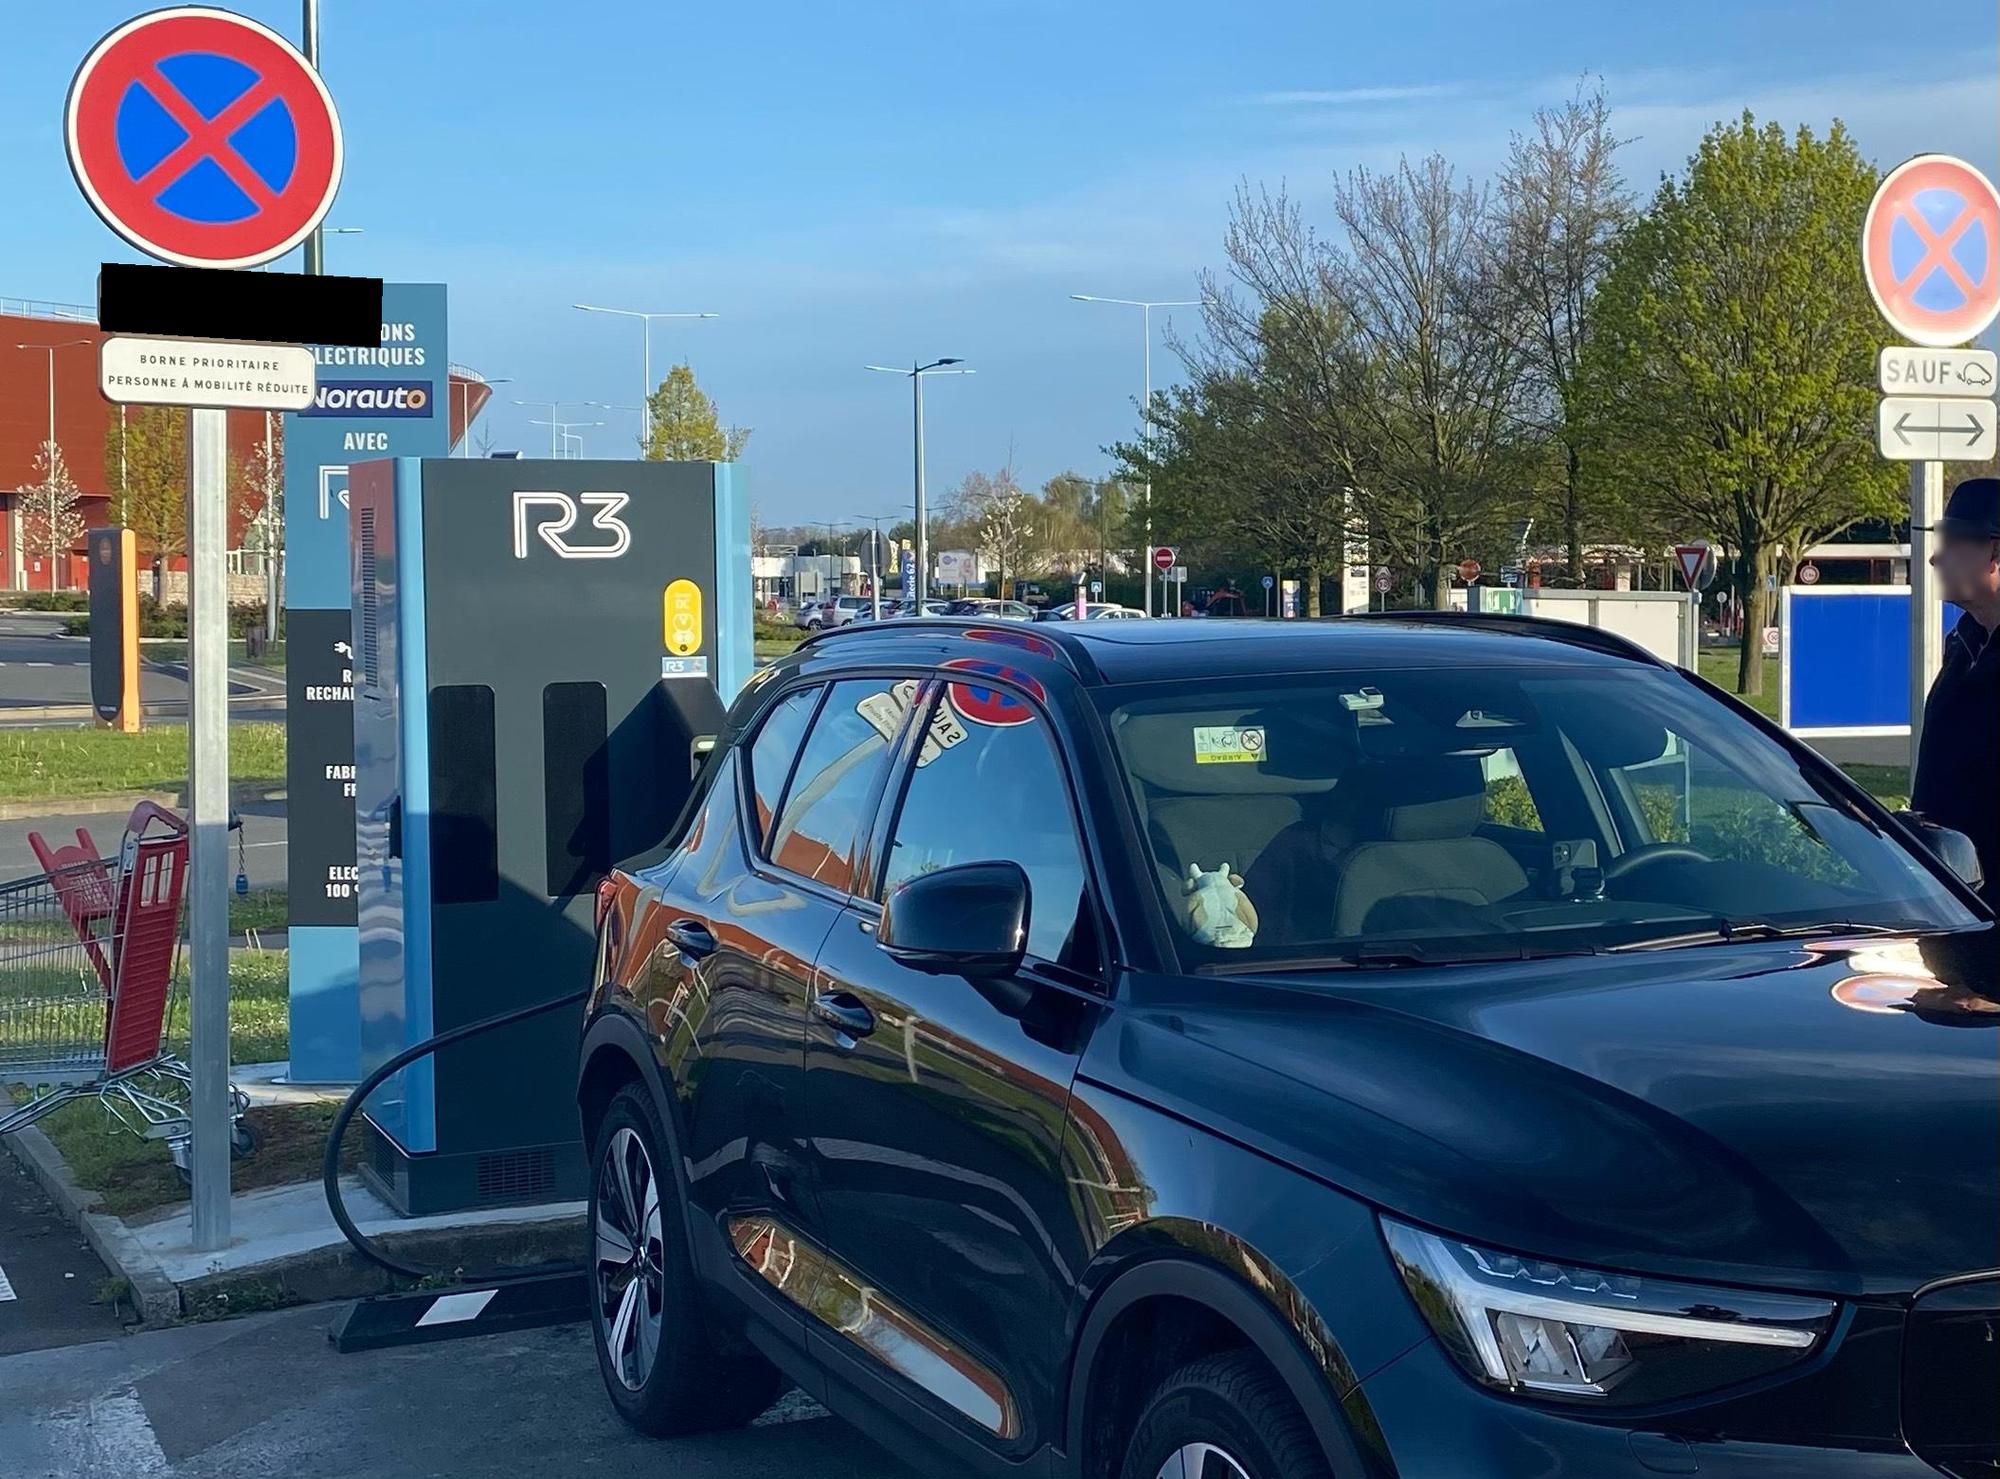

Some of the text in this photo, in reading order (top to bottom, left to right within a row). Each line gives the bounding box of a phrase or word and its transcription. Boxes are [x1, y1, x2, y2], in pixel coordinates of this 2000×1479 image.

[140, 354, 279, 371] BORNE PRIORITAIRE
[307, 346, 425, 368] LECTRIQUES
[1886, 359, 1952, 384] SAUF
[108, 375, 177, 388] PERSONNE
[194, 379, 252, 392] MOBILITÉ
[257, 382, 309, 394] RÉDUITE
[314, 386, 427, 410] Norauto
[343, 432, 389, 451] AVEC
[513, 491, 631, 559] R3
[325, 883, 350, 898] 100
